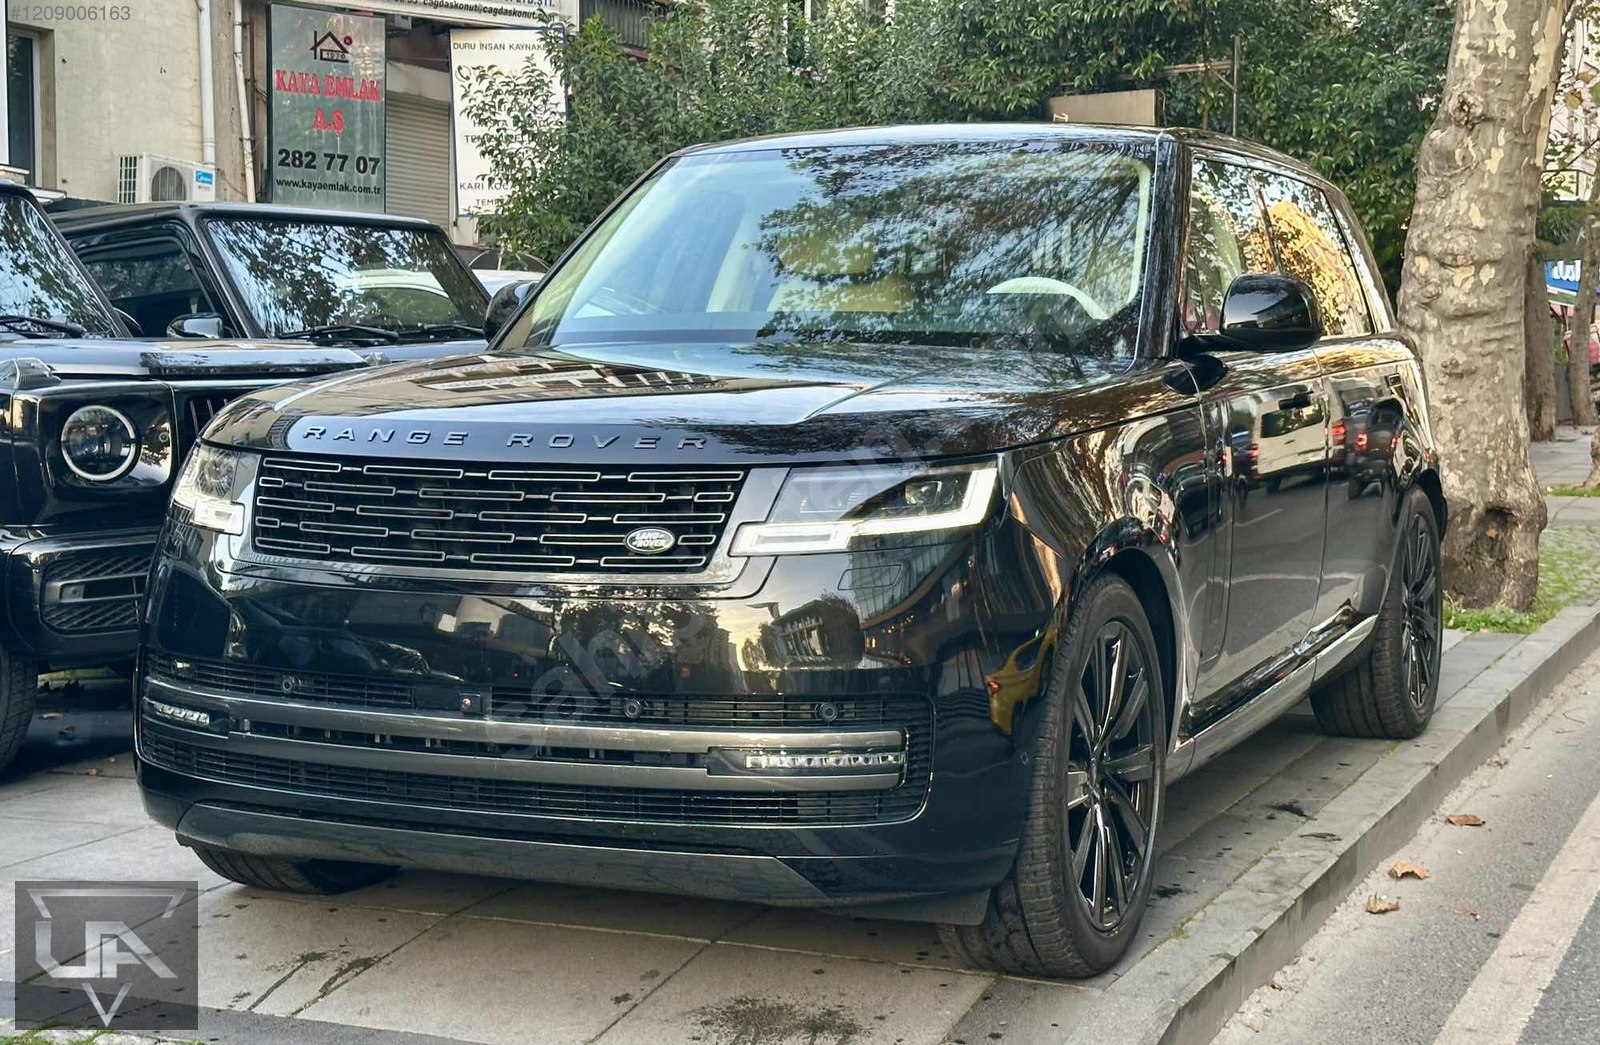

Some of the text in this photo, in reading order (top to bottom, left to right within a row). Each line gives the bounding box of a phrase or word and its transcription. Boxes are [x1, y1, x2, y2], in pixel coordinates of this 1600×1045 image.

[453, 42, 476, 50] DURU
[479, 41, 506, 51] İNSAN
[275, 69, 380, 102] KAYA EMLAK
[278, 149, 381, 175] 282 77 07
[276, 178, 381, 195] www.kayaemlak.com.tr
[302, 425, 708, 451] RANGE ROVER
[635, 532, 660, 540] LAND
[636, 539, 666, 548] ROVER
